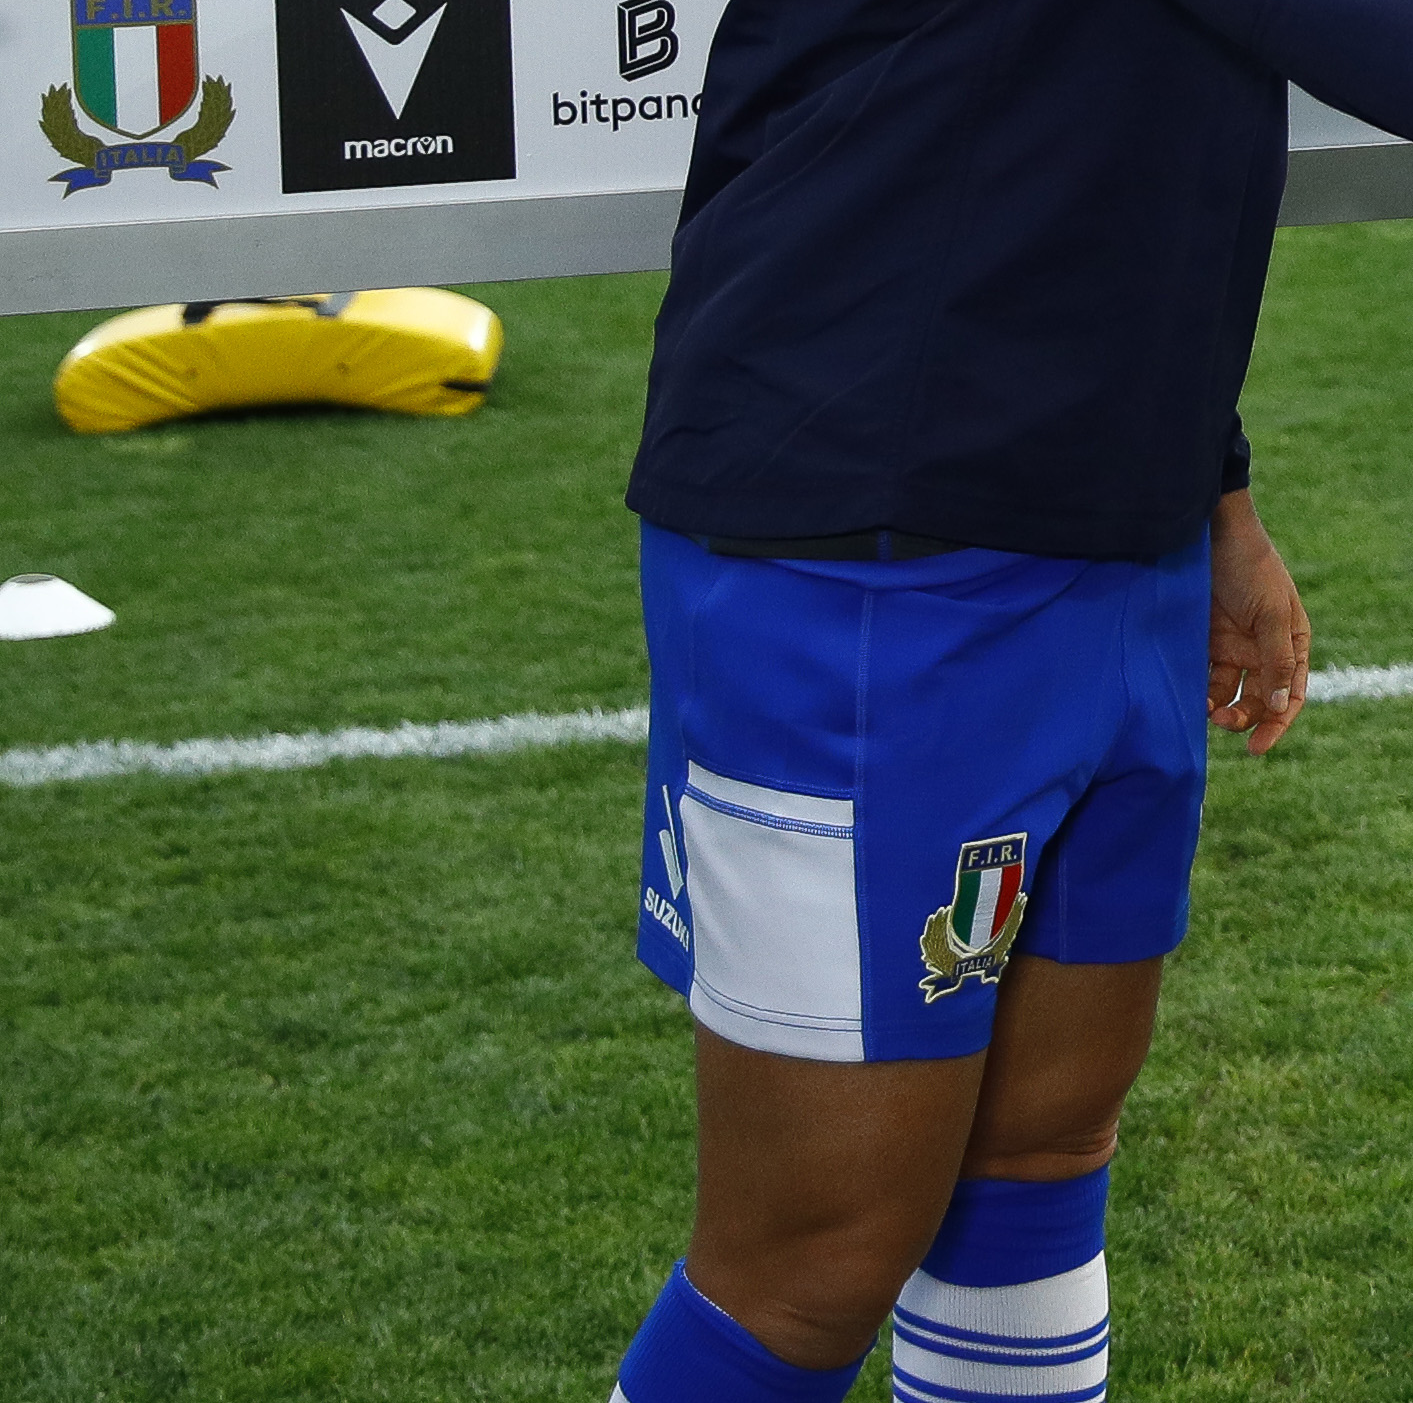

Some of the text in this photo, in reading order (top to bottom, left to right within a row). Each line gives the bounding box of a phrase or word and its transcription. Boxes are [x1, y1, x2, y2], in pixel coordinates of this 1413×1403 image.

[553, 92, 701, 132] bitpan
[100, 144, 180, 165] ITALIA
[345, 136, 453, 159] macron
[968, 844, 1019, 867] F.I.R.
[956, 956, 992, 977] ITALIA
